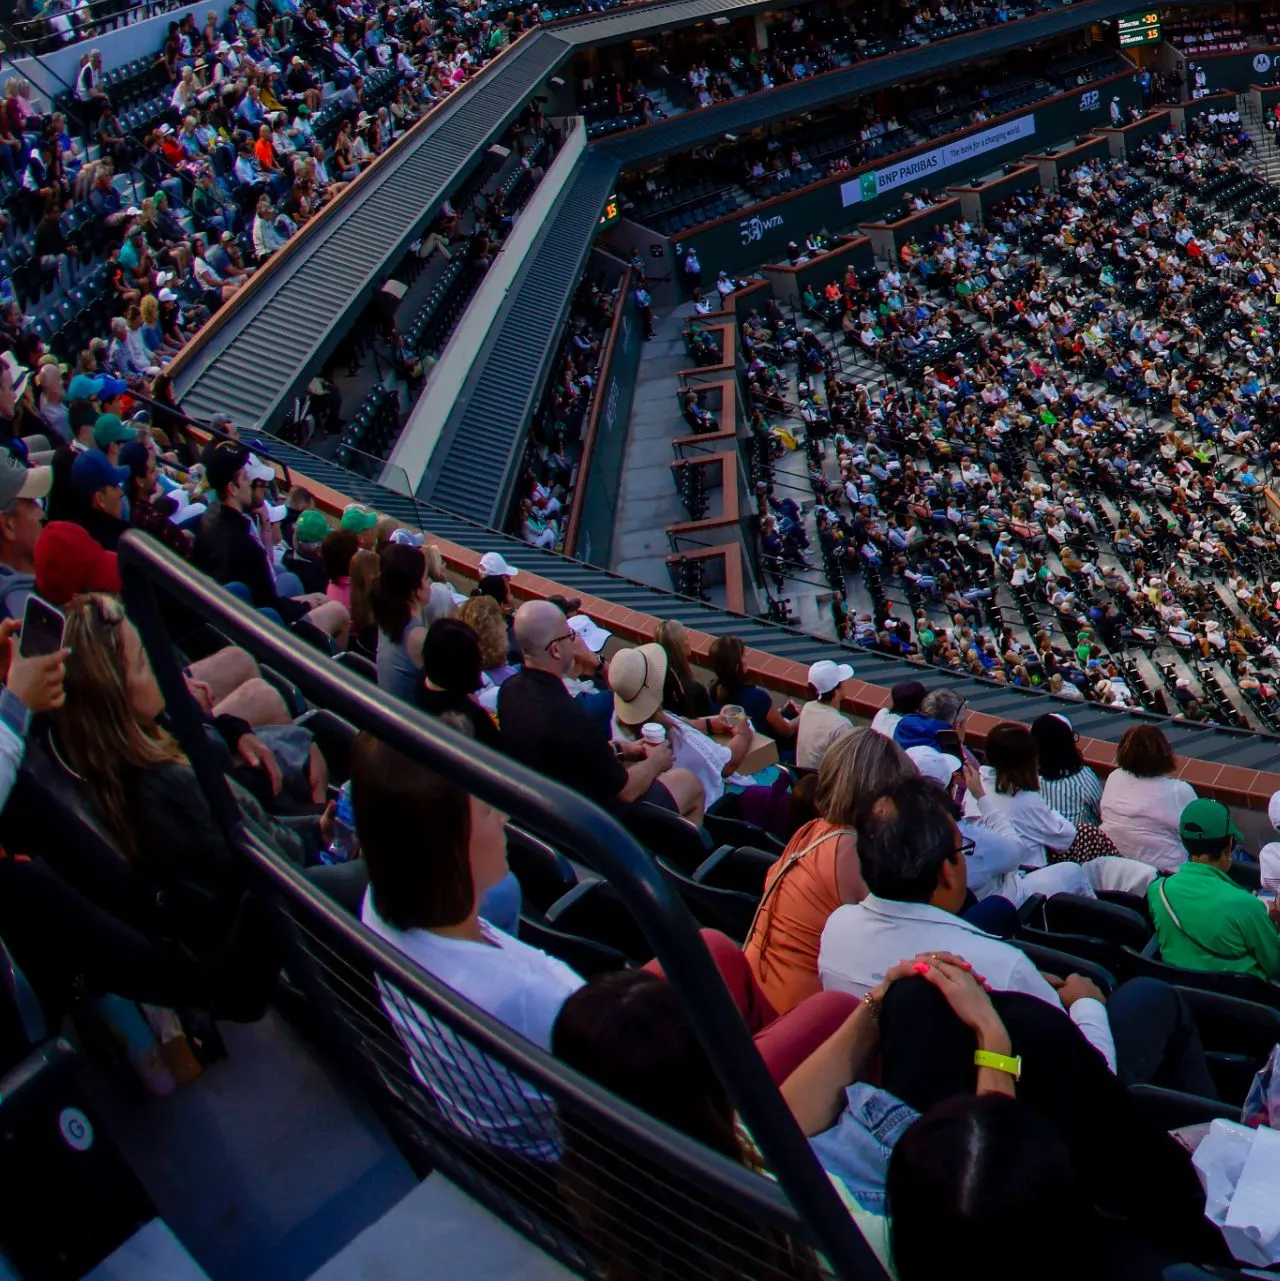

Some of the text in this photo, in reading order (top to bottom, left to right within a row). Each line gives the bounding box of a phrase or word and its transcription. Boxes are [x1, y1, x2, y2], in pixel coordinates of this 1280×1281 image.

[1145, 14, 1157, 23] 30
[1147, 29, 1158, 39] 15
[1189, 62, 1195, 70] 6
[1080, 90, 1099, 107] ATP
[951, 147, 961, 157] The
[961, 143, 973, 154] bank
[973, 141, 981, 153] for
[985, 131, 1007, 145] changing
[1006, 125, 1020, 138] world
[879, 155, 938, 187] BNP PARIBAS
[763, 215, 784, 230] WTA
[675, 243, 682, 254] 5
